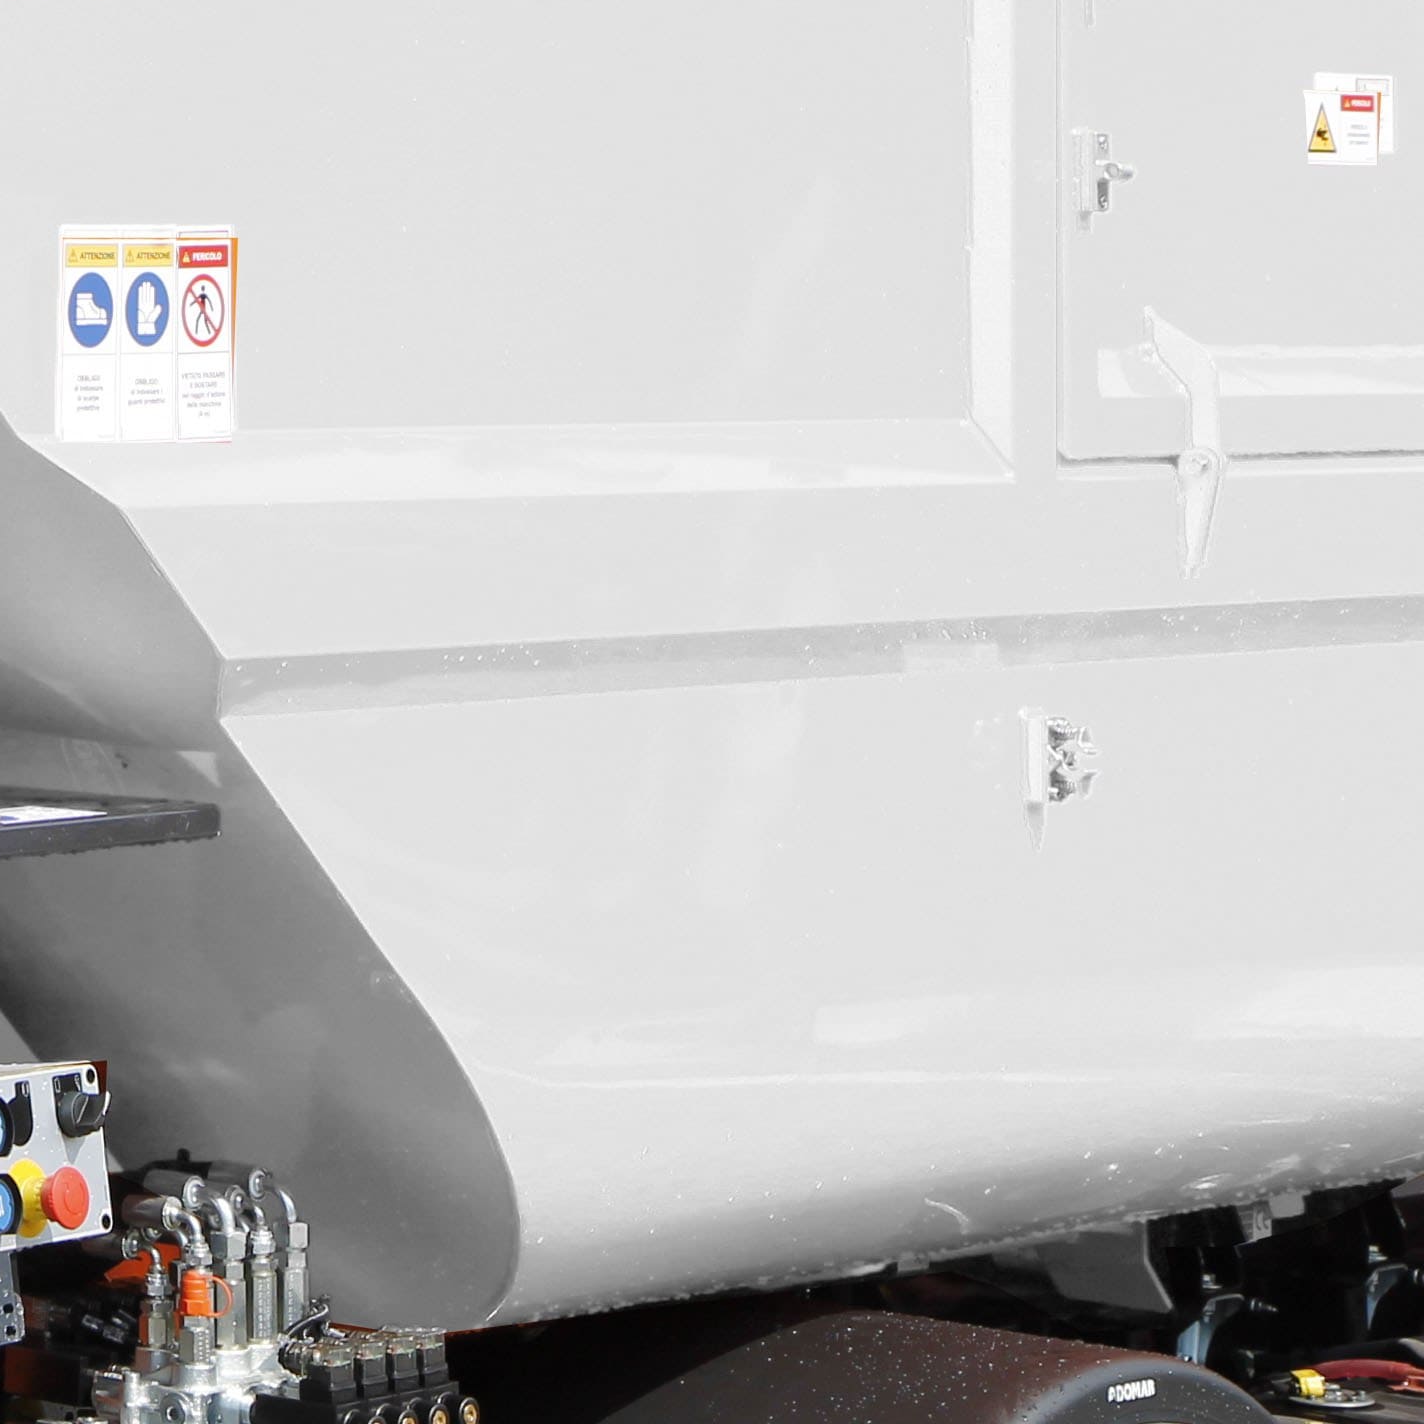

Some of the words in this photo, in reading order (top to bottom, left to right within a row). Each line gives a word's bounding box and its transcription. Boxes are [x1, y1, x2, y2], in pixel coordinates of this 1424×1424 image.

[80, 251, 115, 260] ATTENZIONE
[136, 251, 170, 260] ATTENZIONE
[192, 251, 223, 262] PERICOLO
